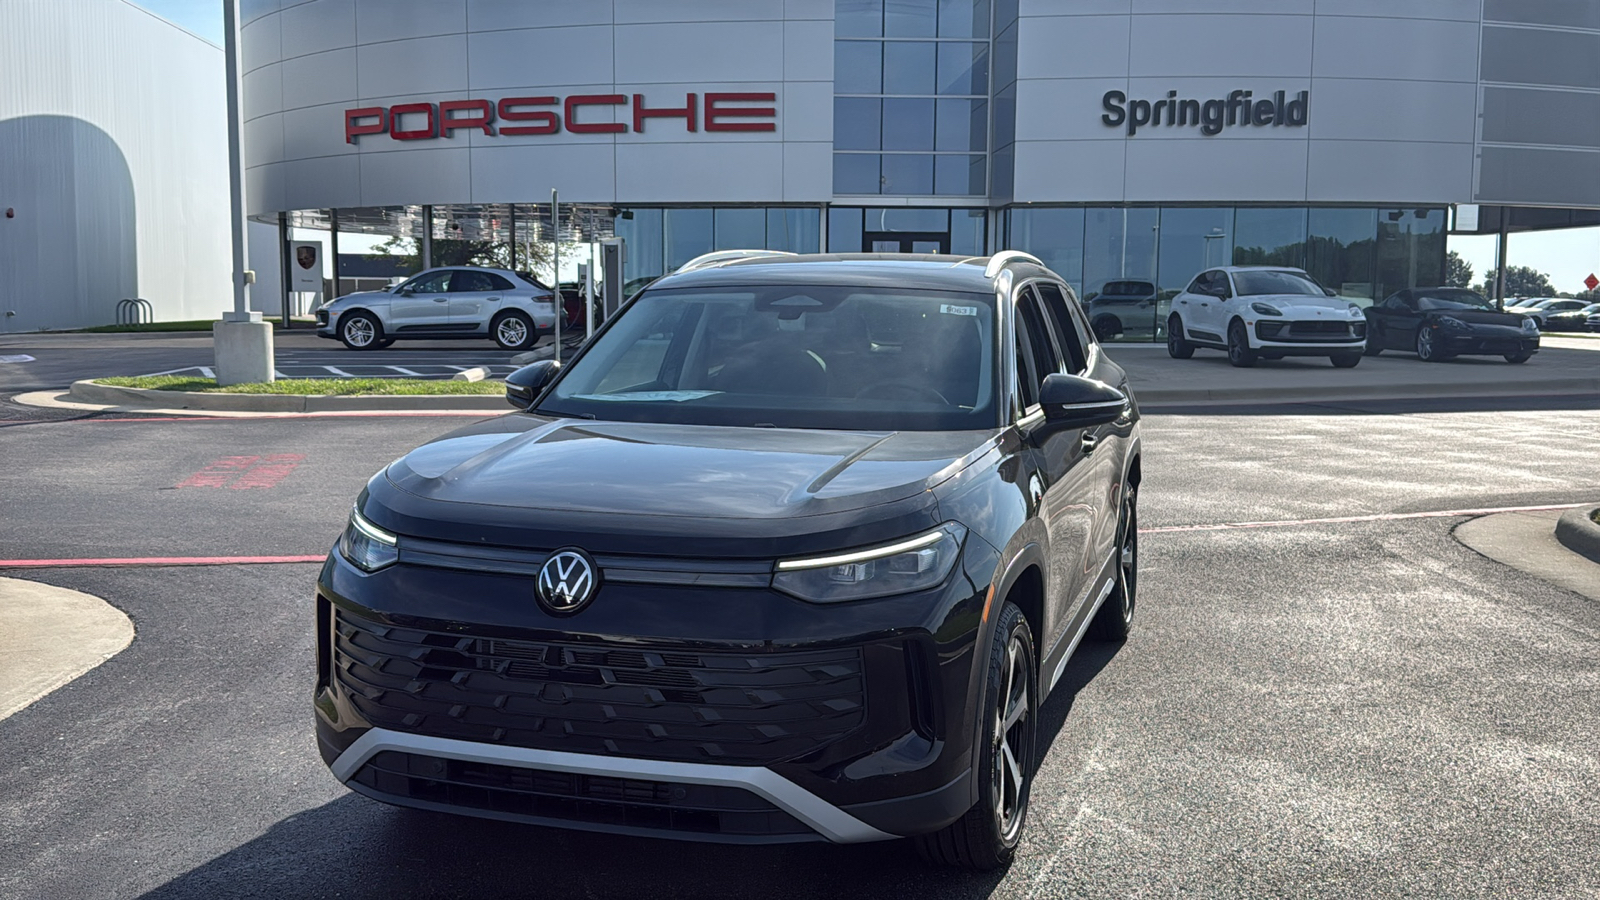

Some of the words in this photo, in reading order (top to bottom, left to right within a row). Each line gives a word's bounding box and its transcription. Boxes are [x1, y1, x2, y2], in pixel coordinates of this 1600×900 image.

[345, 92, 776, 144] PORSCHE
[1101, 90, 1309, 136] Springfield
[539, 551, 592, 609] VW
